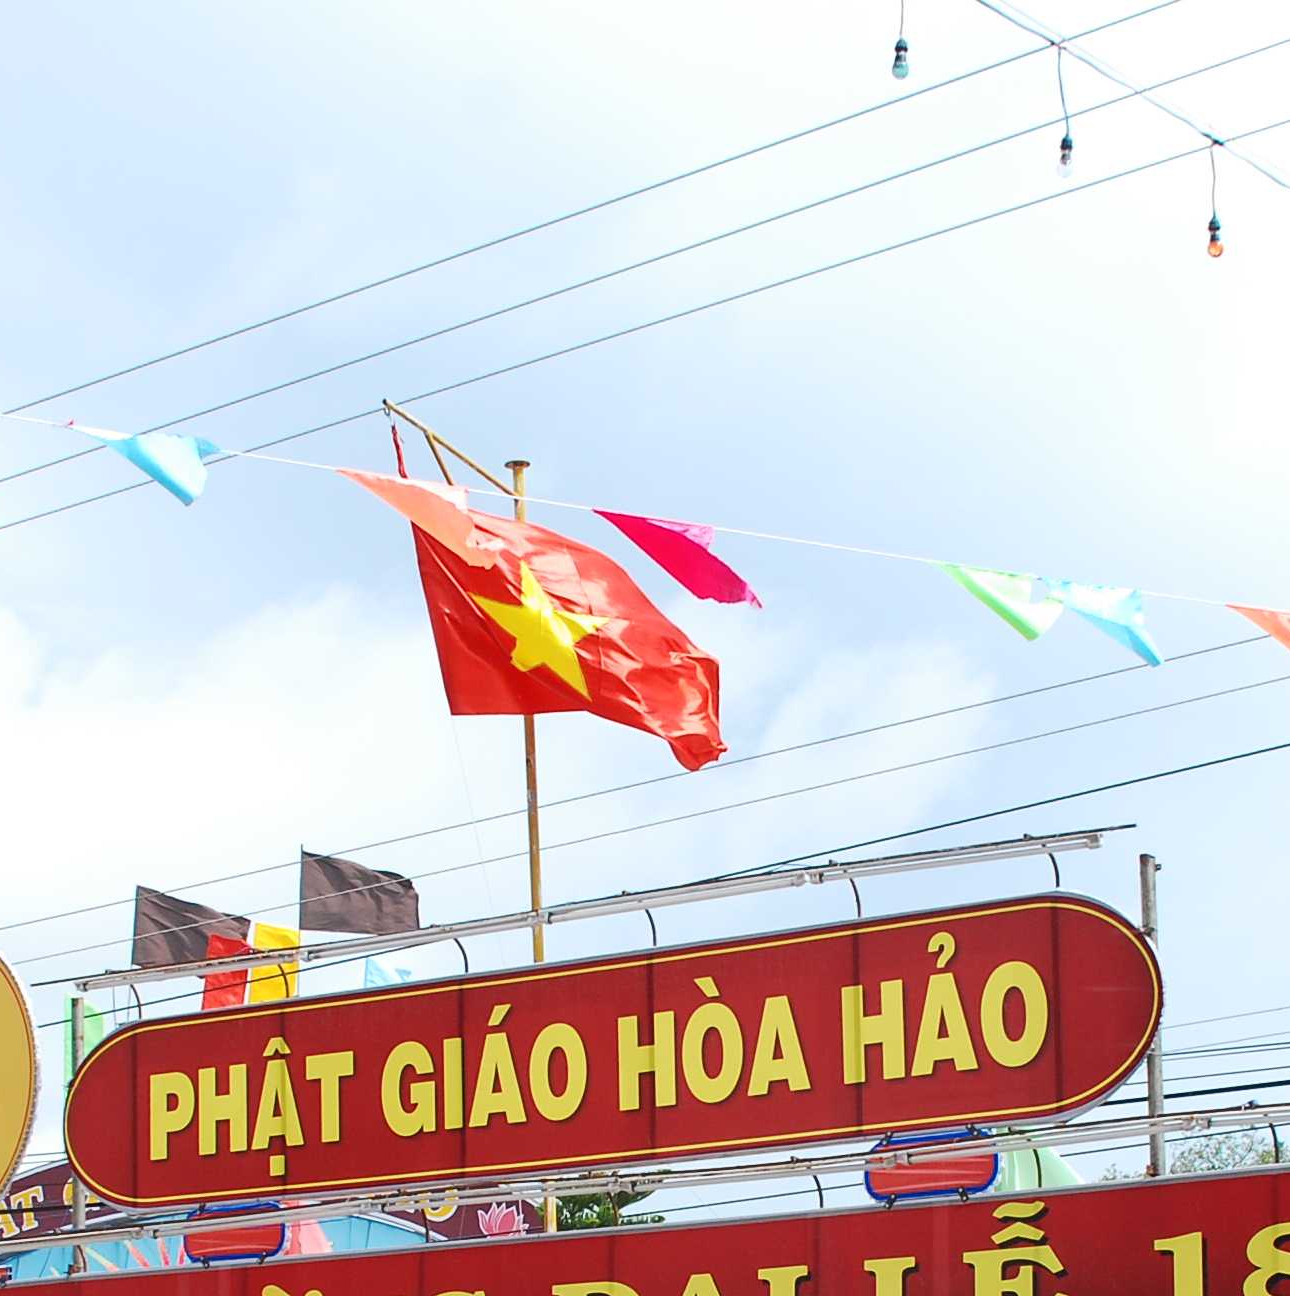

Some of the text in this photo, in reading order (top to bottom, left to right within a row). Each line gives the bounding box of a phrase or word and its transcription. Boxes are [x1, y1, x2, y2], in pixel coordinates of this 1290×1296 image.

[150, 932, 1048, 1176] PHẬT GIÁO HÒA HẢO
